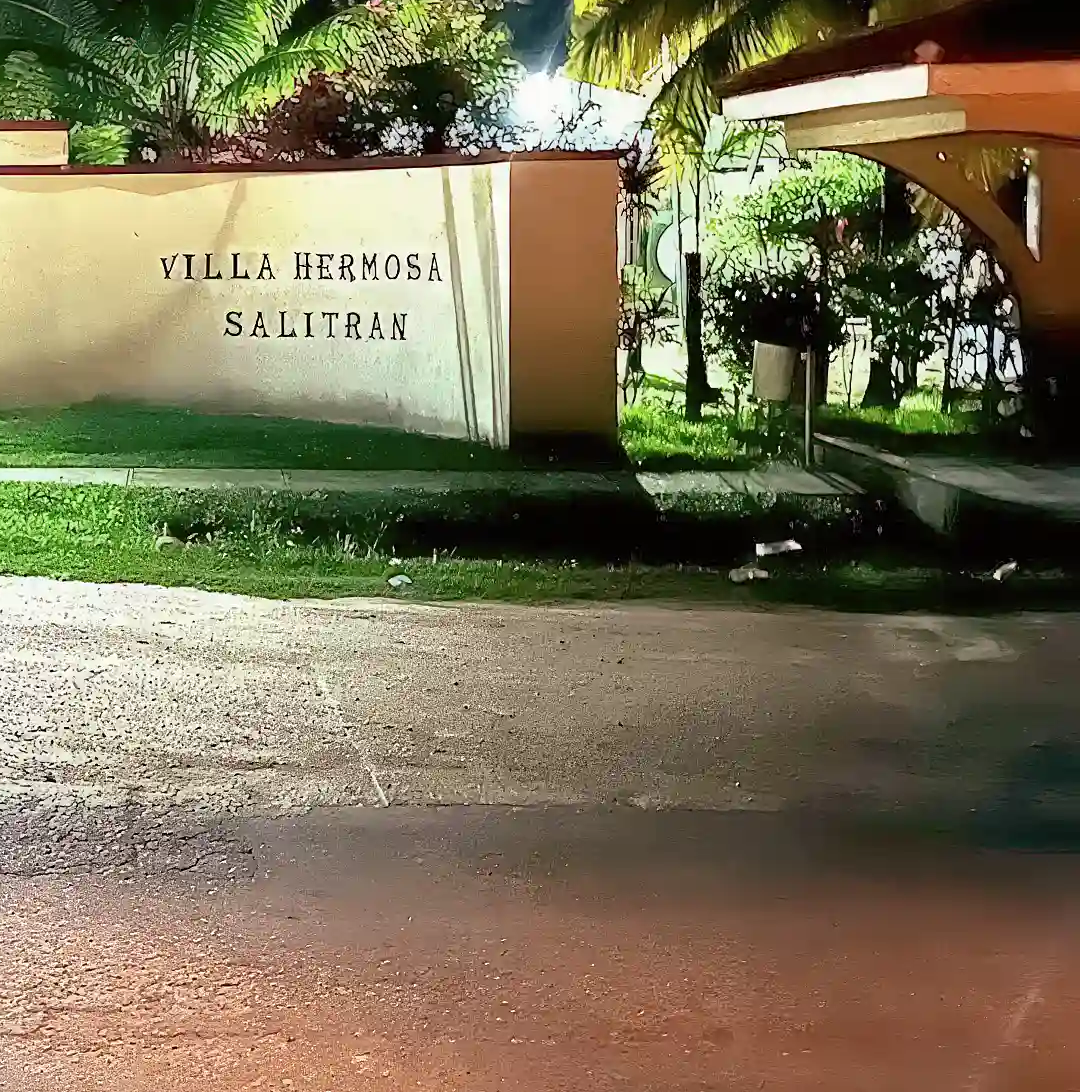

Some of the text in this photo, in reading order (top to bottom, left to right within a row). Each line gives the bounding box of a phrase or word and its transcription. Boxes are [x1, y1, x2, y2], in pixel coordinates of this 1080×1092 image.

[160, 251, 443, 283] VILLA HERMOSA
[223, 310, 408, 341] SALITRAN
